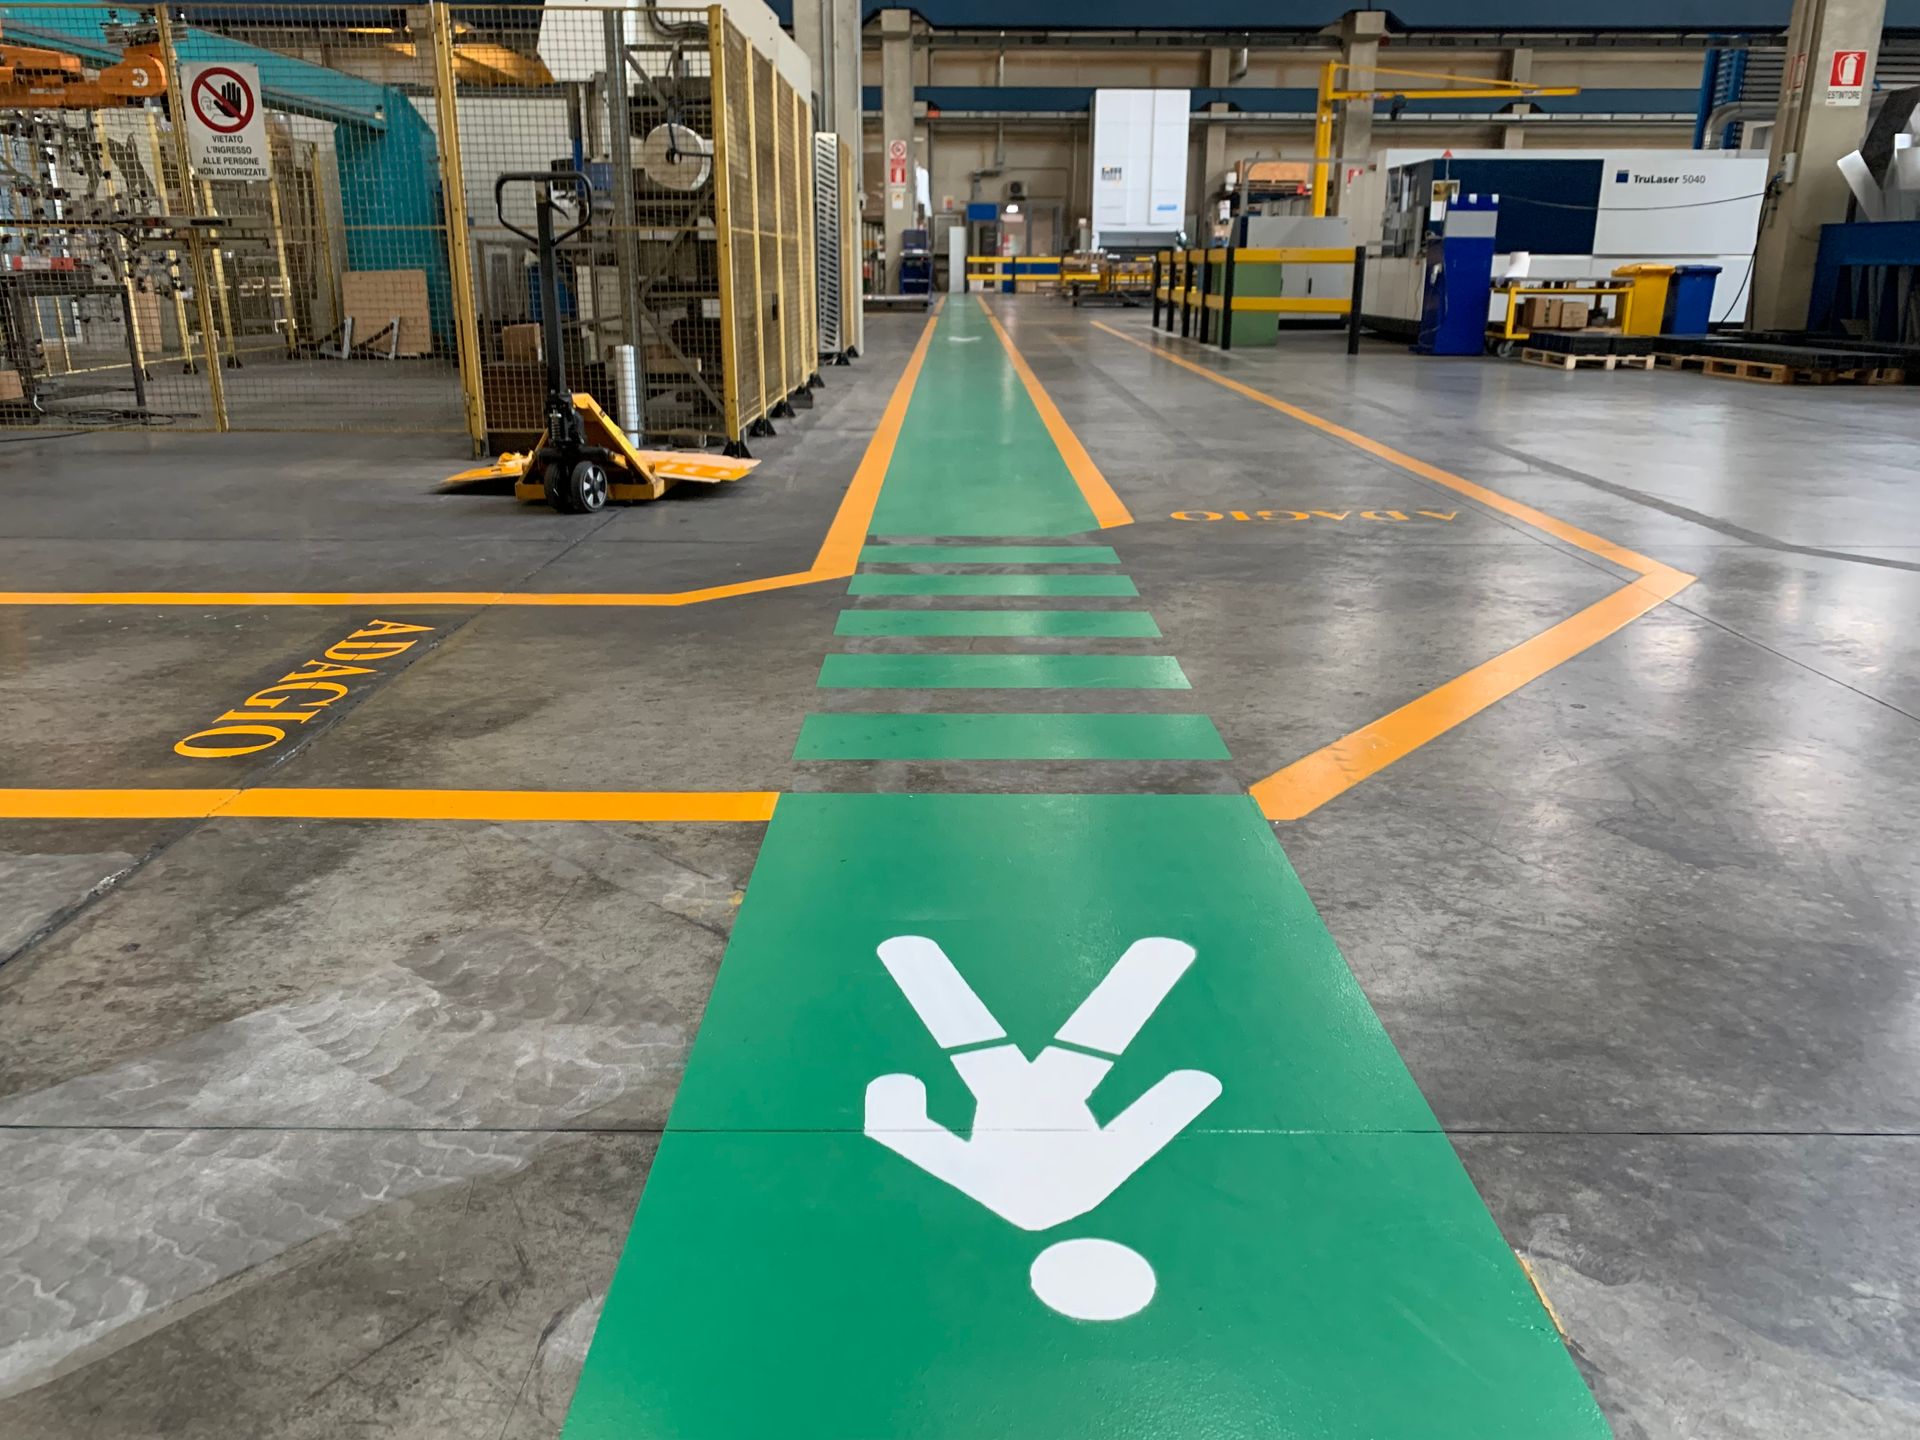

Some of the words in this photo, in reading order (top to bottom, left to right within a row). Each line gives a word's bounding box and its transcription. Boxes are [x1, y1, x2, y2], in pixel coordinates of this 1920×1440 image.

[1827, 90, 1861, 99] ESTINTORE
[212, 135, 244, 144] VIETATO
[206, 146, 252, 154] L'INGRESSO
[202, 157, 221, 165] ALLE
[223, 157, 260, 165] PERSONE
[197, 167, 214, 175] NON
[216, 167, 267, 176] AUTORIZZATE
[1634, 174, 1680, 184] TruLaser
[1682, 174, 1706, 184] 5040
[1170, 509, 1462, 522] ADAGIO
[174, 618, 435, 758] ADAGIO
